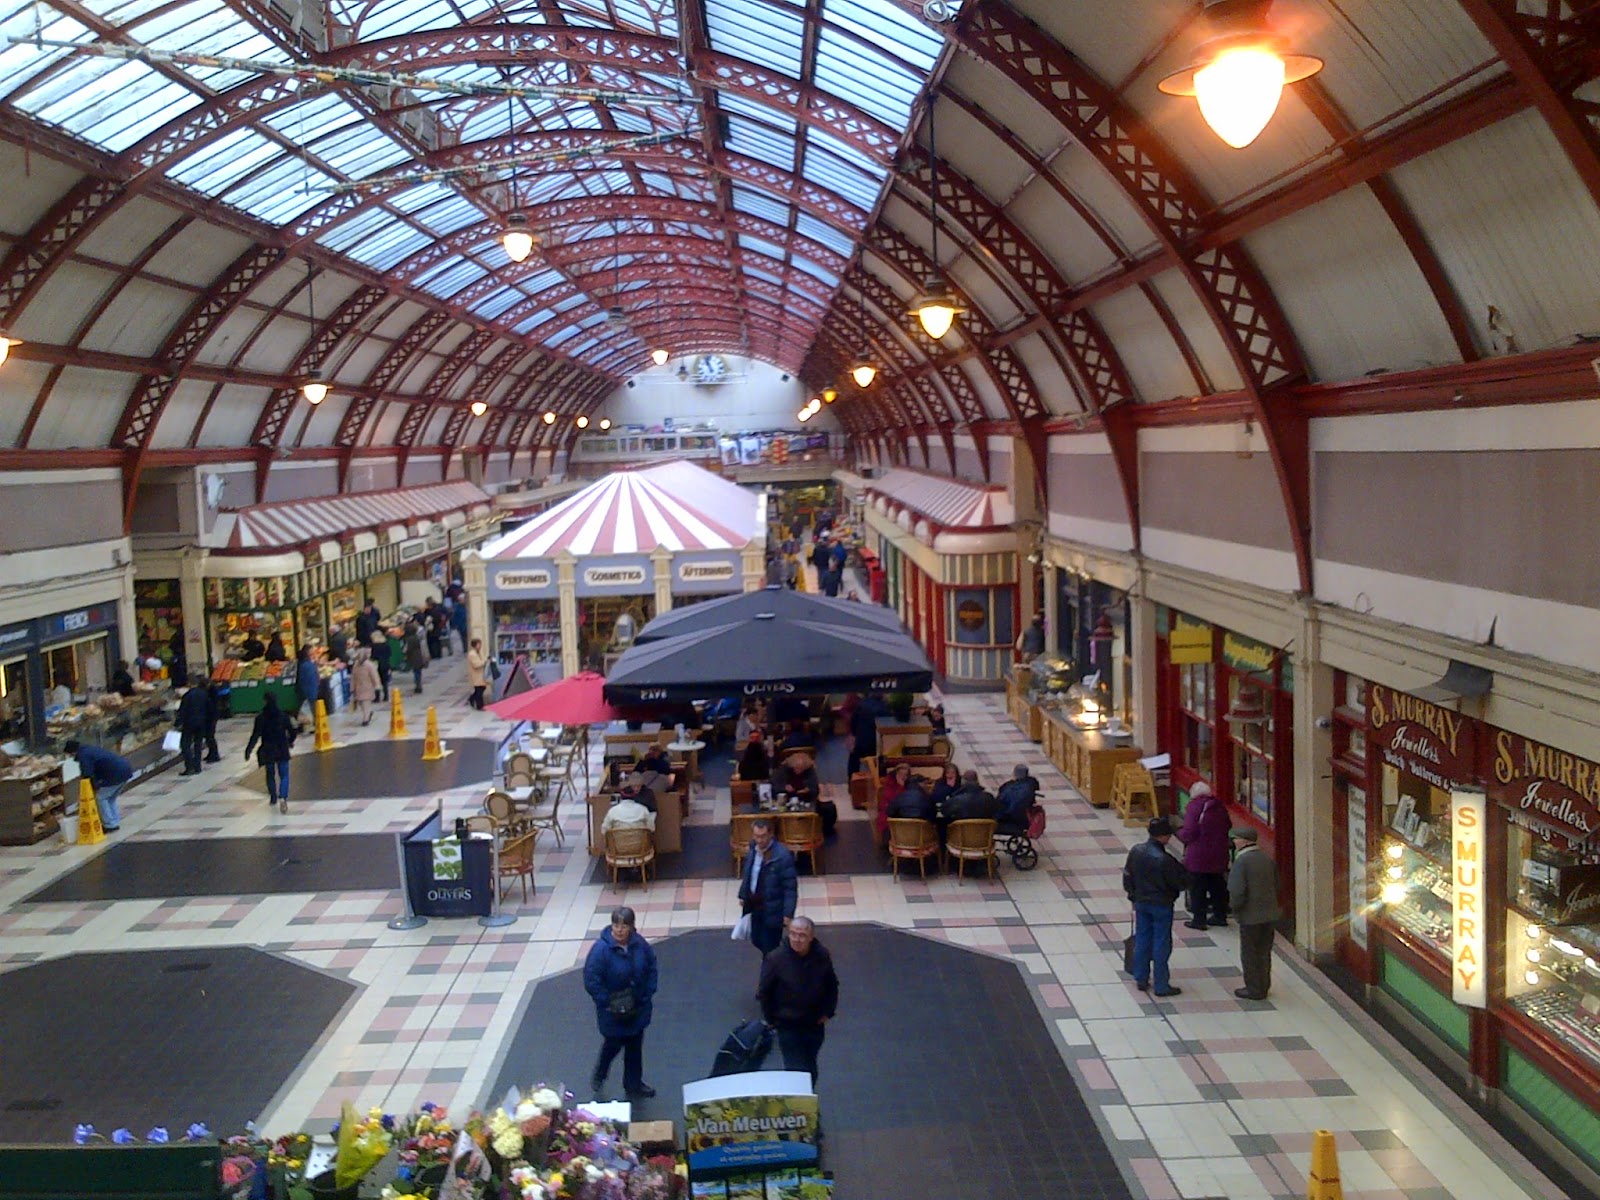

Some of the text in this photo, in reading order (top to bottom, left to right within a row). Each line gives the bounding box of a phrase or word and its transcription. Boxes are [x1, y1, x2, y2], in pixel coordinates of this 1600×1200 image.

[1391, 691, 1463, 758] MURRAY
[1520, 781, 1592, 833] Jewellers
[427, 888, 472, 901] OLIVERS
[1456, 840, 1477, 991] MURRAY
[697, 1114, 807, 1135] Van Meuwen
